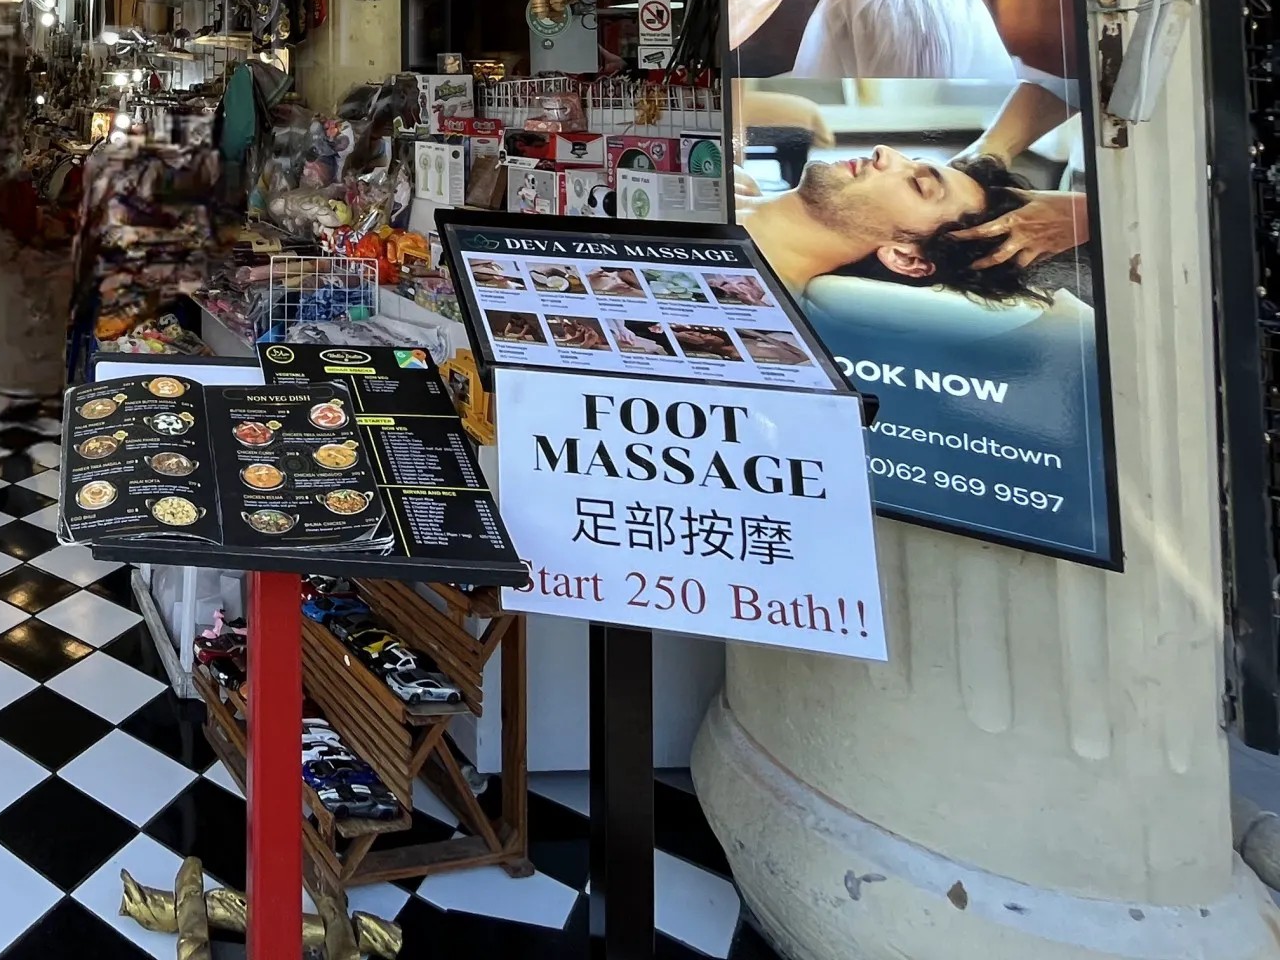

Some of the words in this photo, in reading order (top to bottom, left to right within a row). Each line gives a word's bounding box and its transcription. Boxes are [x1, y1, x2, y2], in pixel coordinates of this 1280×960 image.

[504, 238, 567, 253] DEVA
[572, 242, 618, 256] ZEN
[623, 245, 739, 262] MASSAGE
[833, 356, 907, 387] OOK
[915, 368, 1008, 404] NOW
[582, 393, 748, 444] FOOT
[532, 434, 826, 500] MASSAGE
[864, 421, 1063, 469] vazenoldtown
[933, 470, 986, 496] 969
[994, 484, 1064, 512] 9597
[572, 497, 795, 566] 足部按摩
[513, 559, 605, 602] Start
[624, 571, 706, 615] 250
[728, 583, 868, 638] Bath!!
